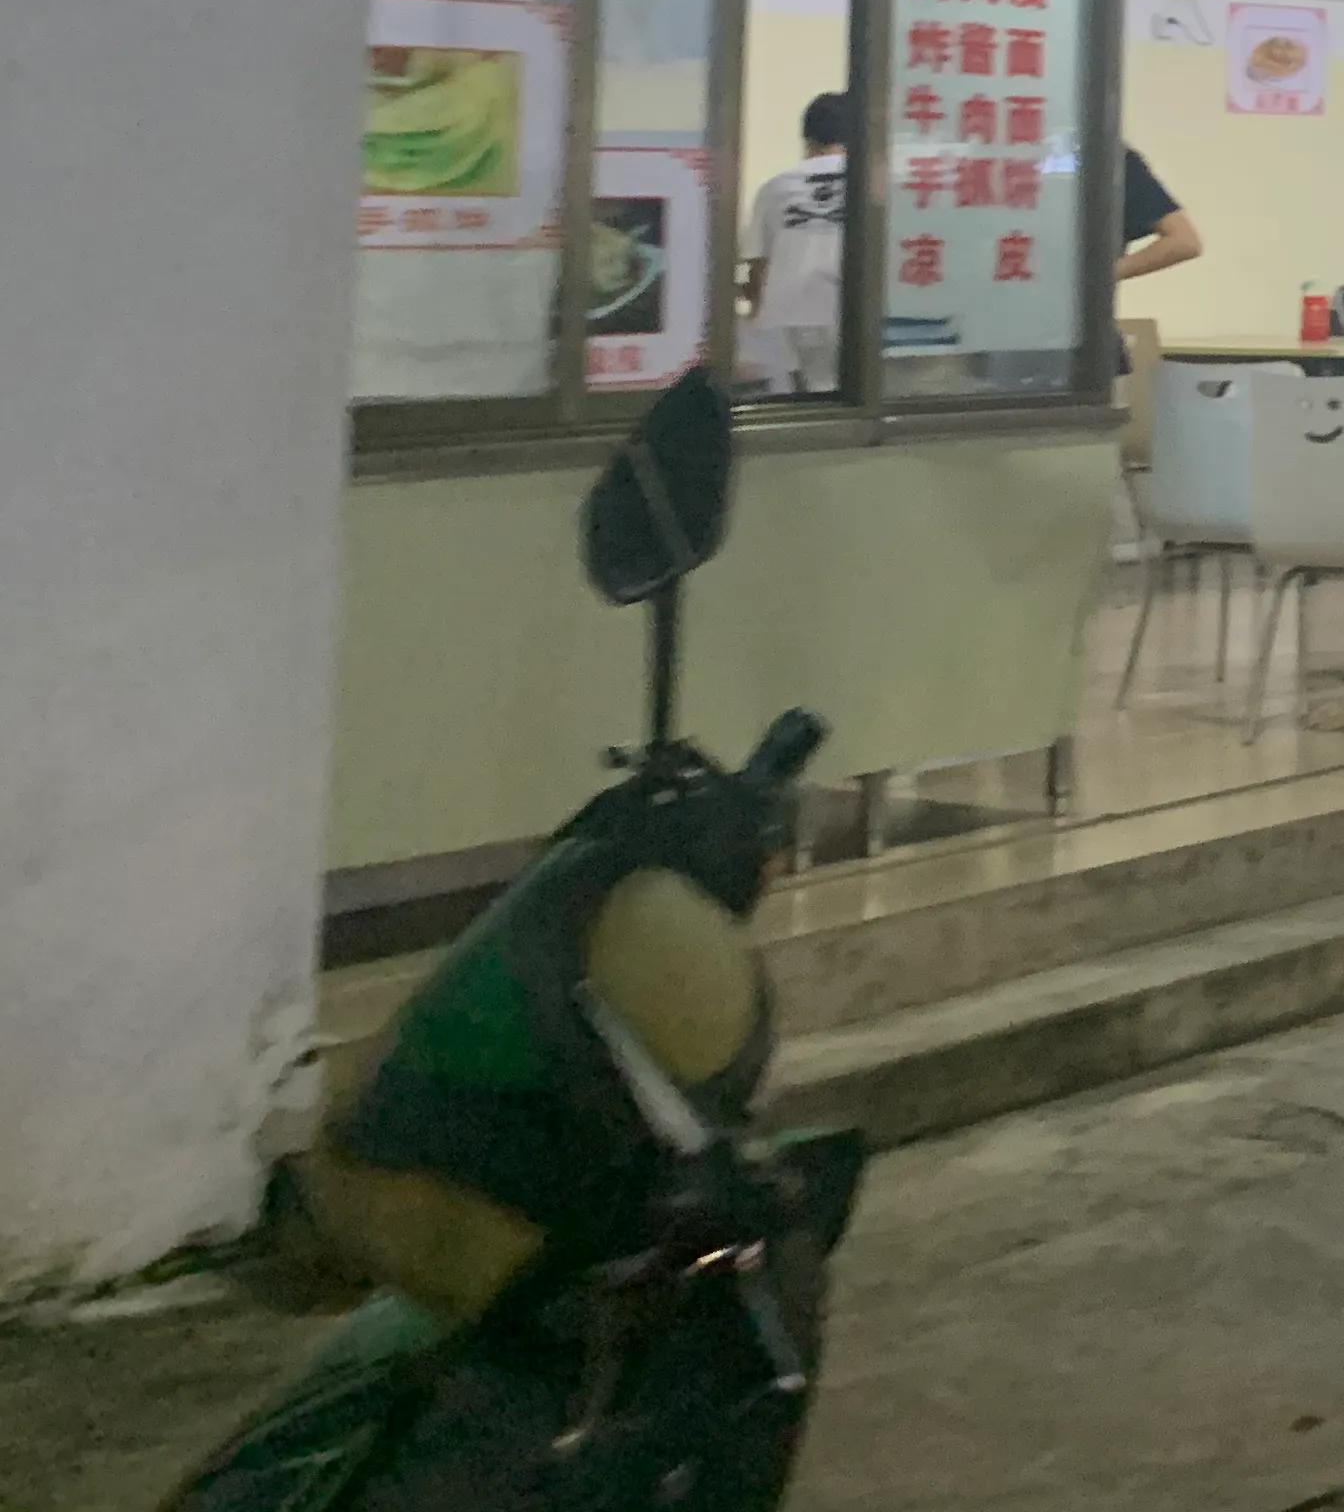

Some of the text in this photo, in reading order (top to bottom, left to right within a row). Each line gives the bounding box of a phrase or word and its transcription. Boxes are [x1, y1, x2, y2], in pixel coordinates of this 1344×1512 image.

[906, 20, 1046, 77] 炸酱面
[903, 85, 1046, 143] 牛肉面
[898, 233, 1034, 286] 凉皮
